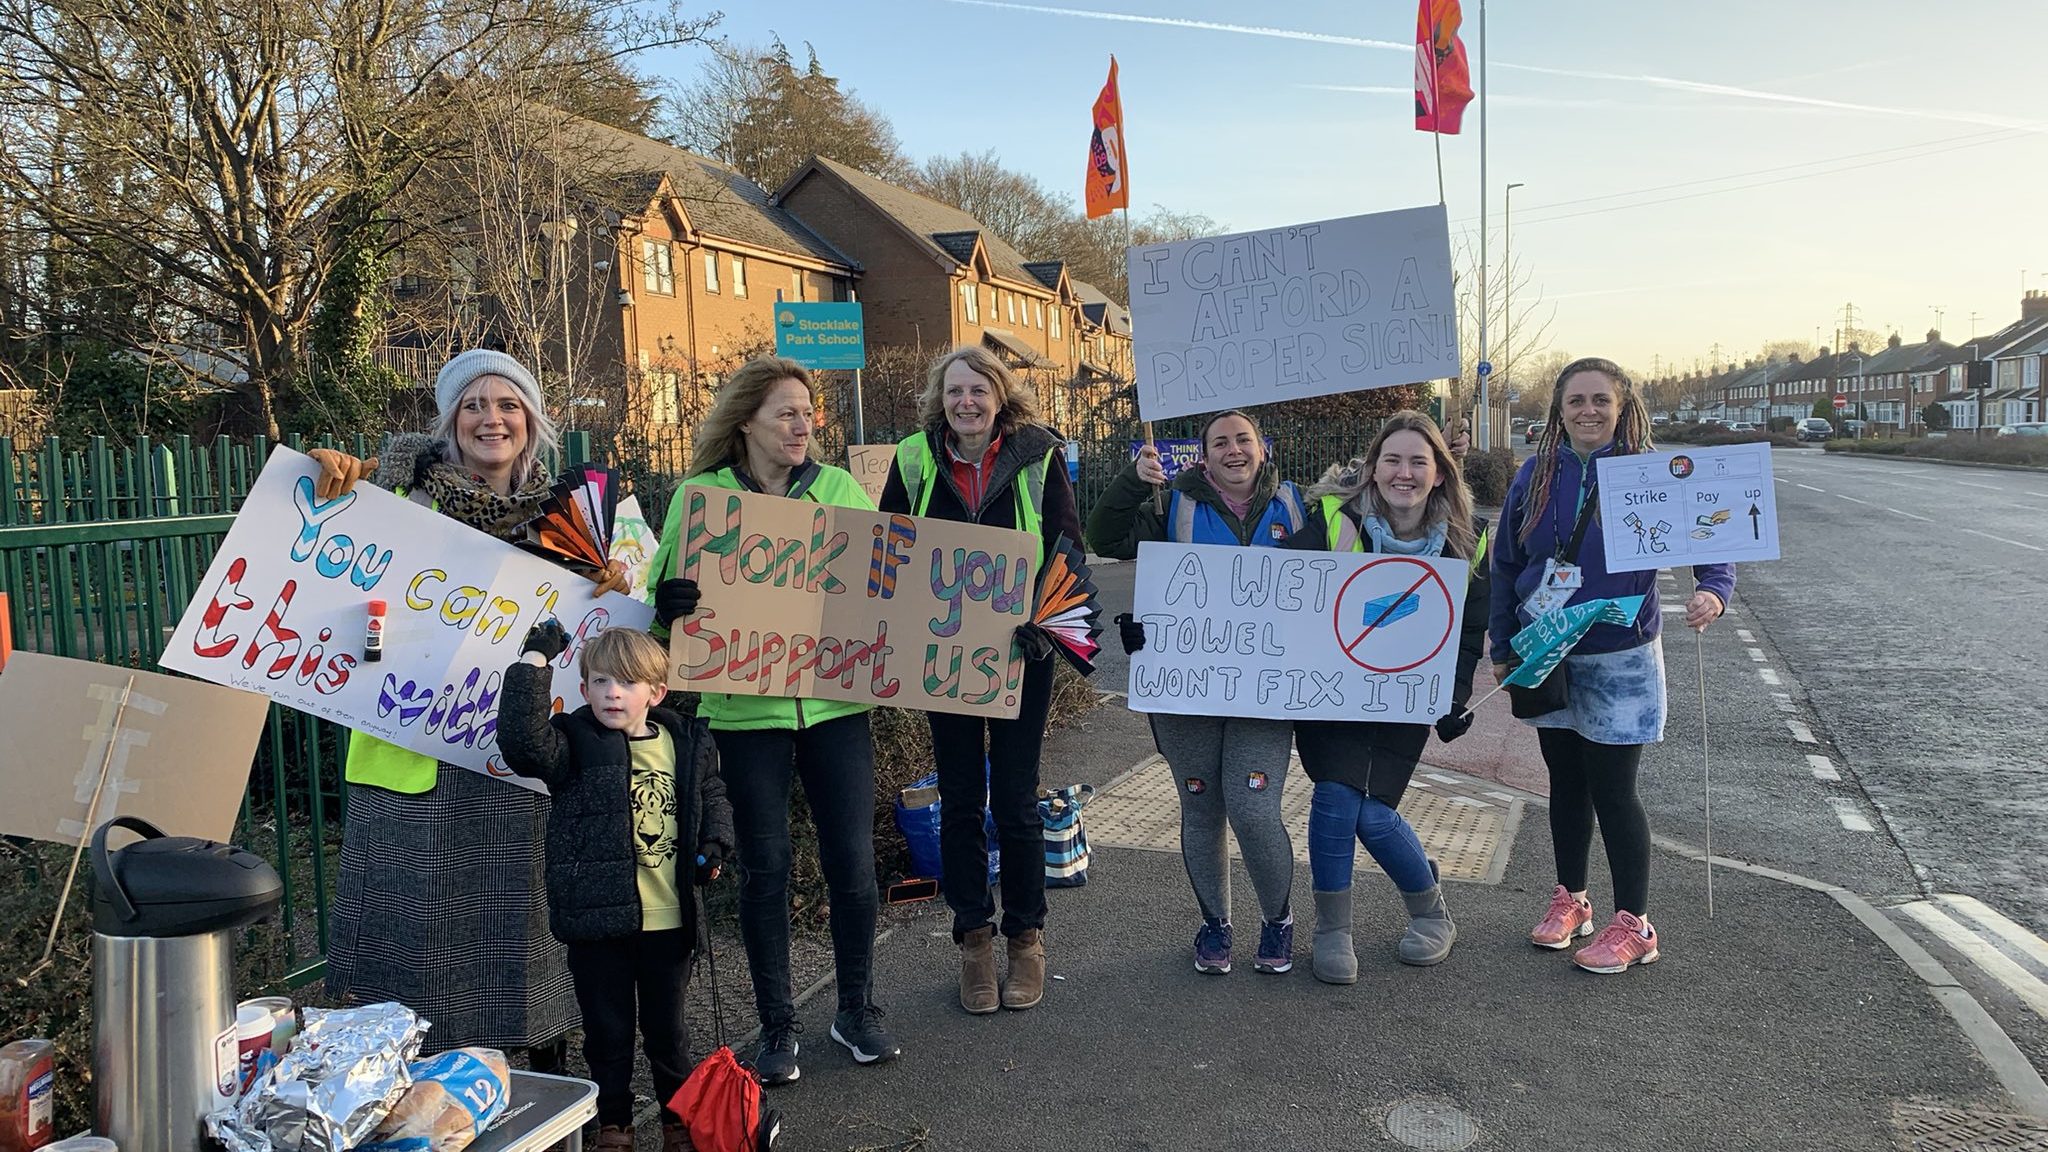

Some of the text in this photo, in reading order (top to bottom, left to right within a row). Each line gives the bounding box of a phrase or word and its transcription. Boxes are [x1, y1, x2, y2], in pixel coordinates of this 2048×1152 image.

[1143, 224, 1321, 295] I CAN'T
[799, 319, 859, 331] Stocklake
[1191, 256, 1430, 343] AFFORD A
[785, 333, 861, 345] Park School
[1152, 313, 1455, 408] PROPER SIGN!
[1170, 444, 1200, 454] THINK
[1624, 488, 1761, 506] Strike Pay up
[290, 476, 393, 591] You
[683, 491, 1027, 638] Honk if you
[1164, 551, 1338, 613] A WET
[193, 557, 500, 750] this with
[678, 607, 900, 698] Support
[923, 633, 1024, 707] us!
[1140, 613, 1286, 657] TOWEL
[230, 673, 266, 693] We've
[273, 691, 290, 700] run
[297, 698, 316, 708] out
[321, 706, 331, 714] of
[1134, 664, 1441, 716] WON'T FIX IT!
[464, 1079, 498, 1114] 12
